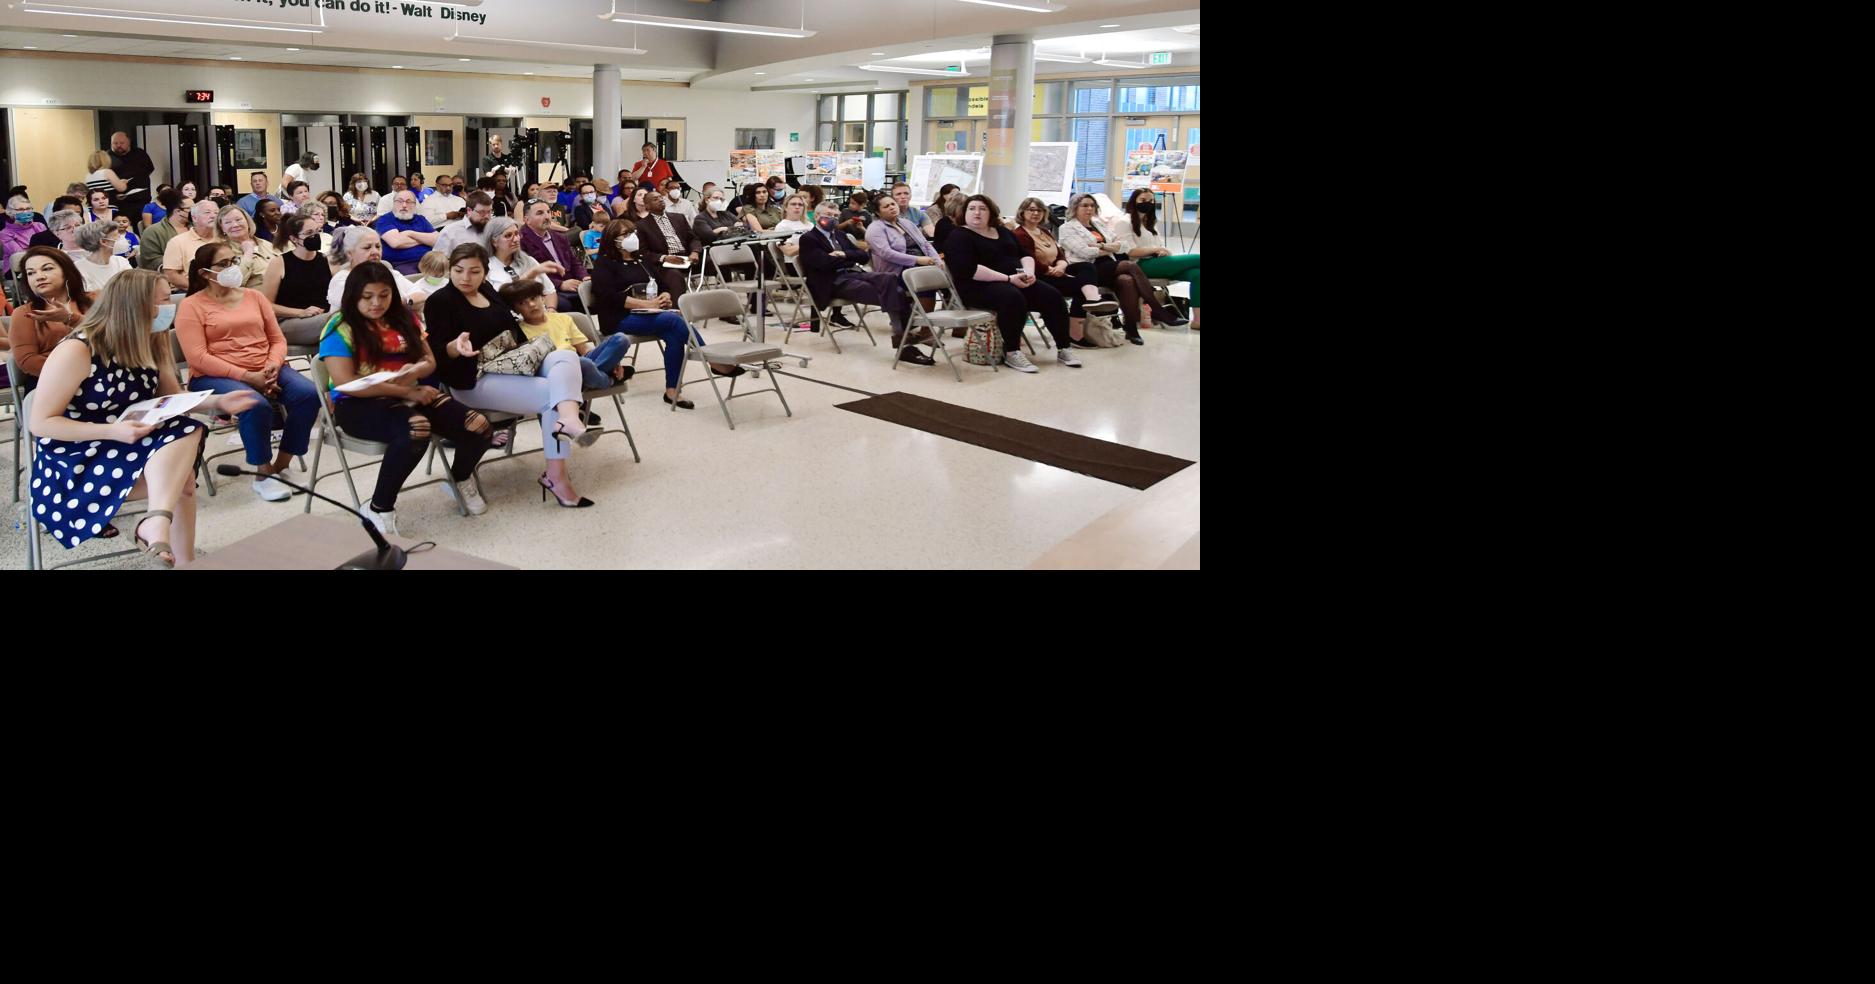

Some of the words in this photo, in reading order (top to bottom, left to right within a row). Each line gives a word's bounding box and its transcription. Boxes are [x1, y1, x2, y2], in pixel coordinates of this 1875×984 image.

[280, 0, 310, 8] you
[315, 0, 345, 9] can
[350, 0, 371, 12] do
[400, 3, 433, 17] Walt
[440, 6, 486, 25] Disney
[1152, 53, 1169, 64] EXIT
